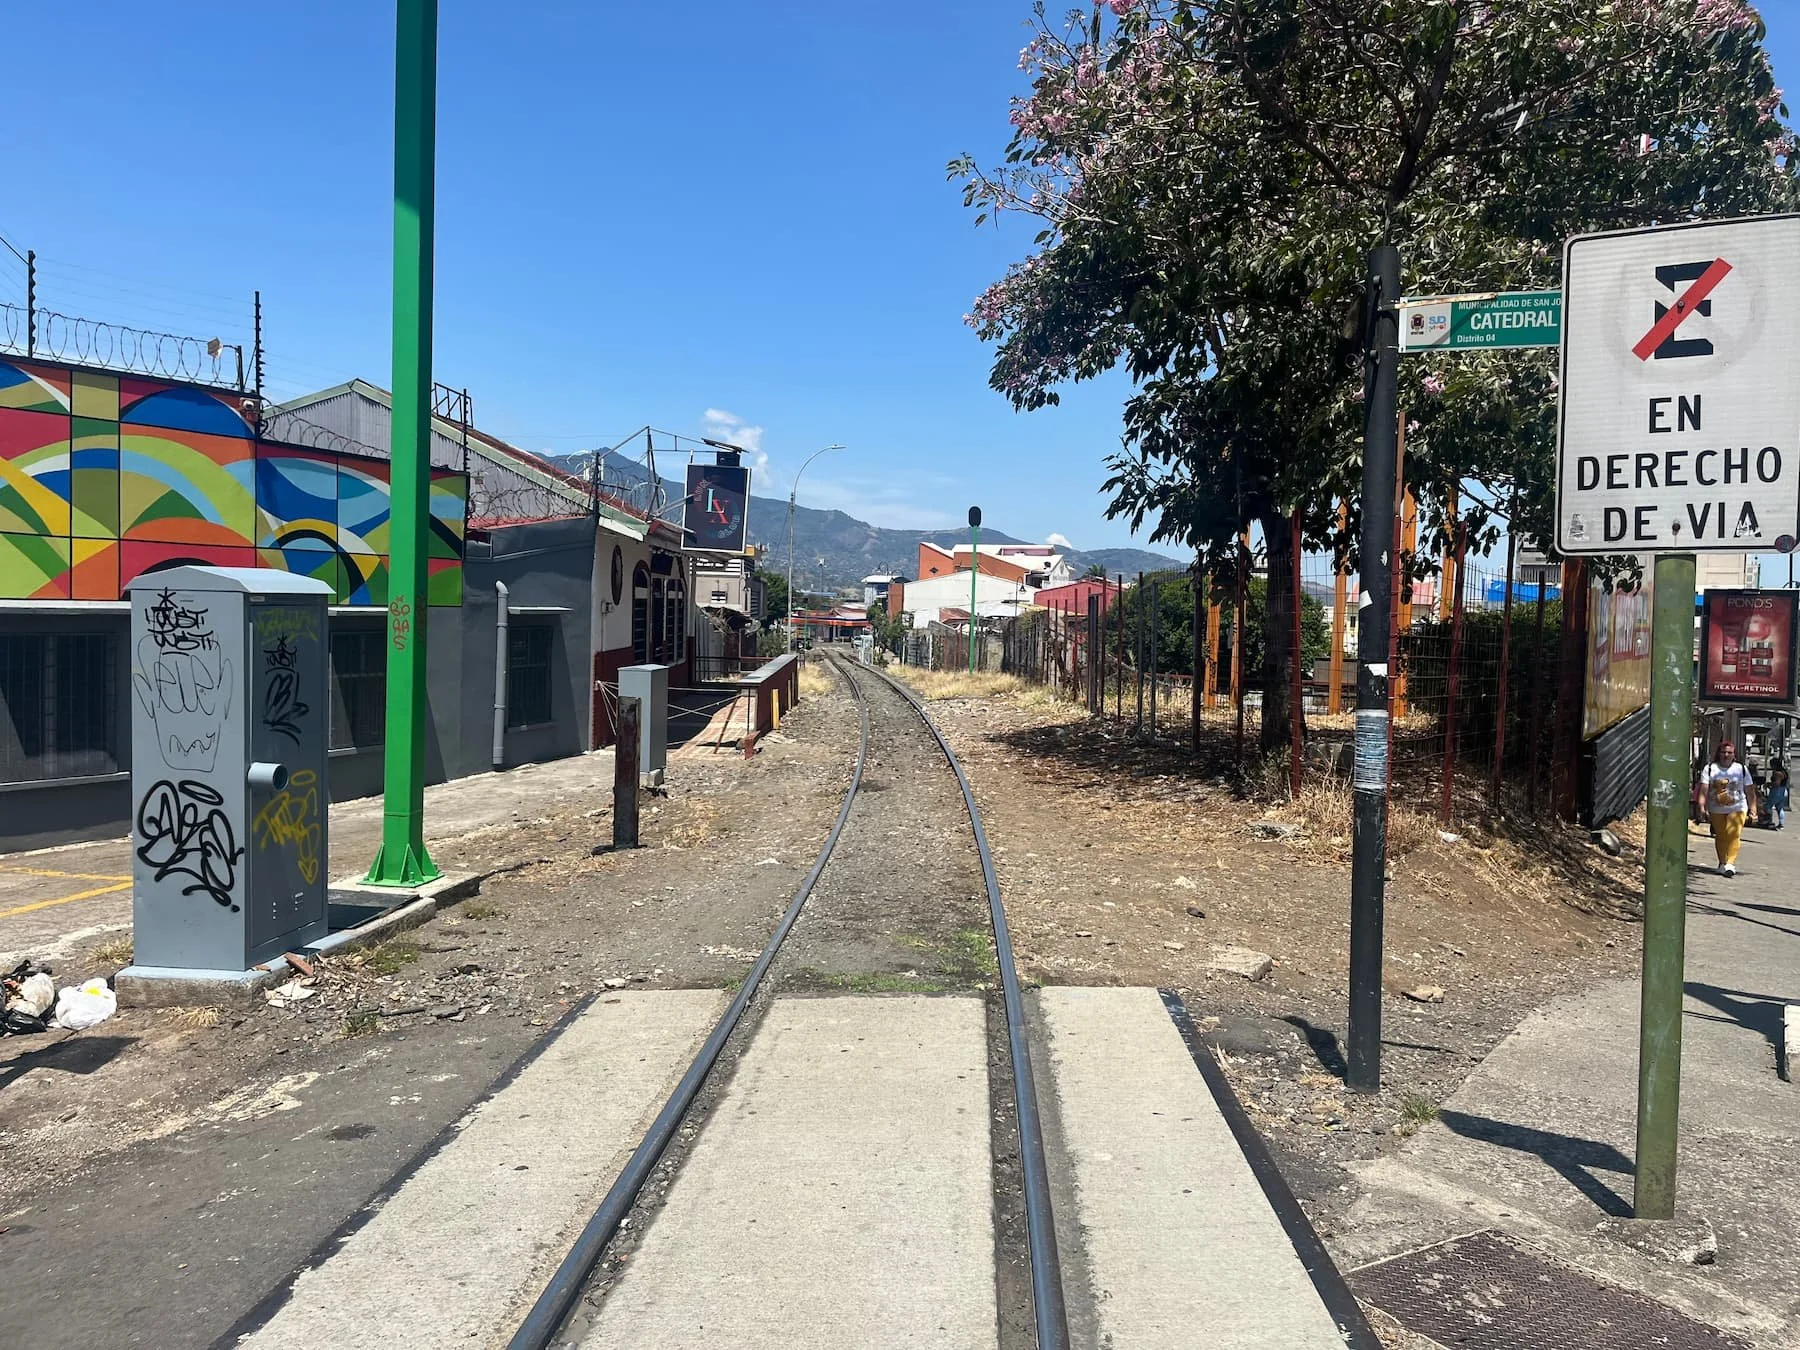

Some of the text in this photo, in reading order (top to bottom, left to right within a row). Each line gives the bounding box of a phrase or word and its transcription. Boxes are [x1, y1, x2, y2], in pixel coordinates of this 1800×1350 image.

[1458, 297, 1561, 311] MUNICIPALIDAD DE SAN JO
[1470, 310, 1557, 330] CATEDRAL
[1457, 334, 1496, 343] Distrito 04
[1649, 395, 1701, 433] EN
[1577, 447, 1782, 491] DERECHO
[1603, 505, 1658, 542] DE
[1686, 501, 1762, 539] VIA
[1714, 684, 1779, 692] HEXYL-RETINOL
